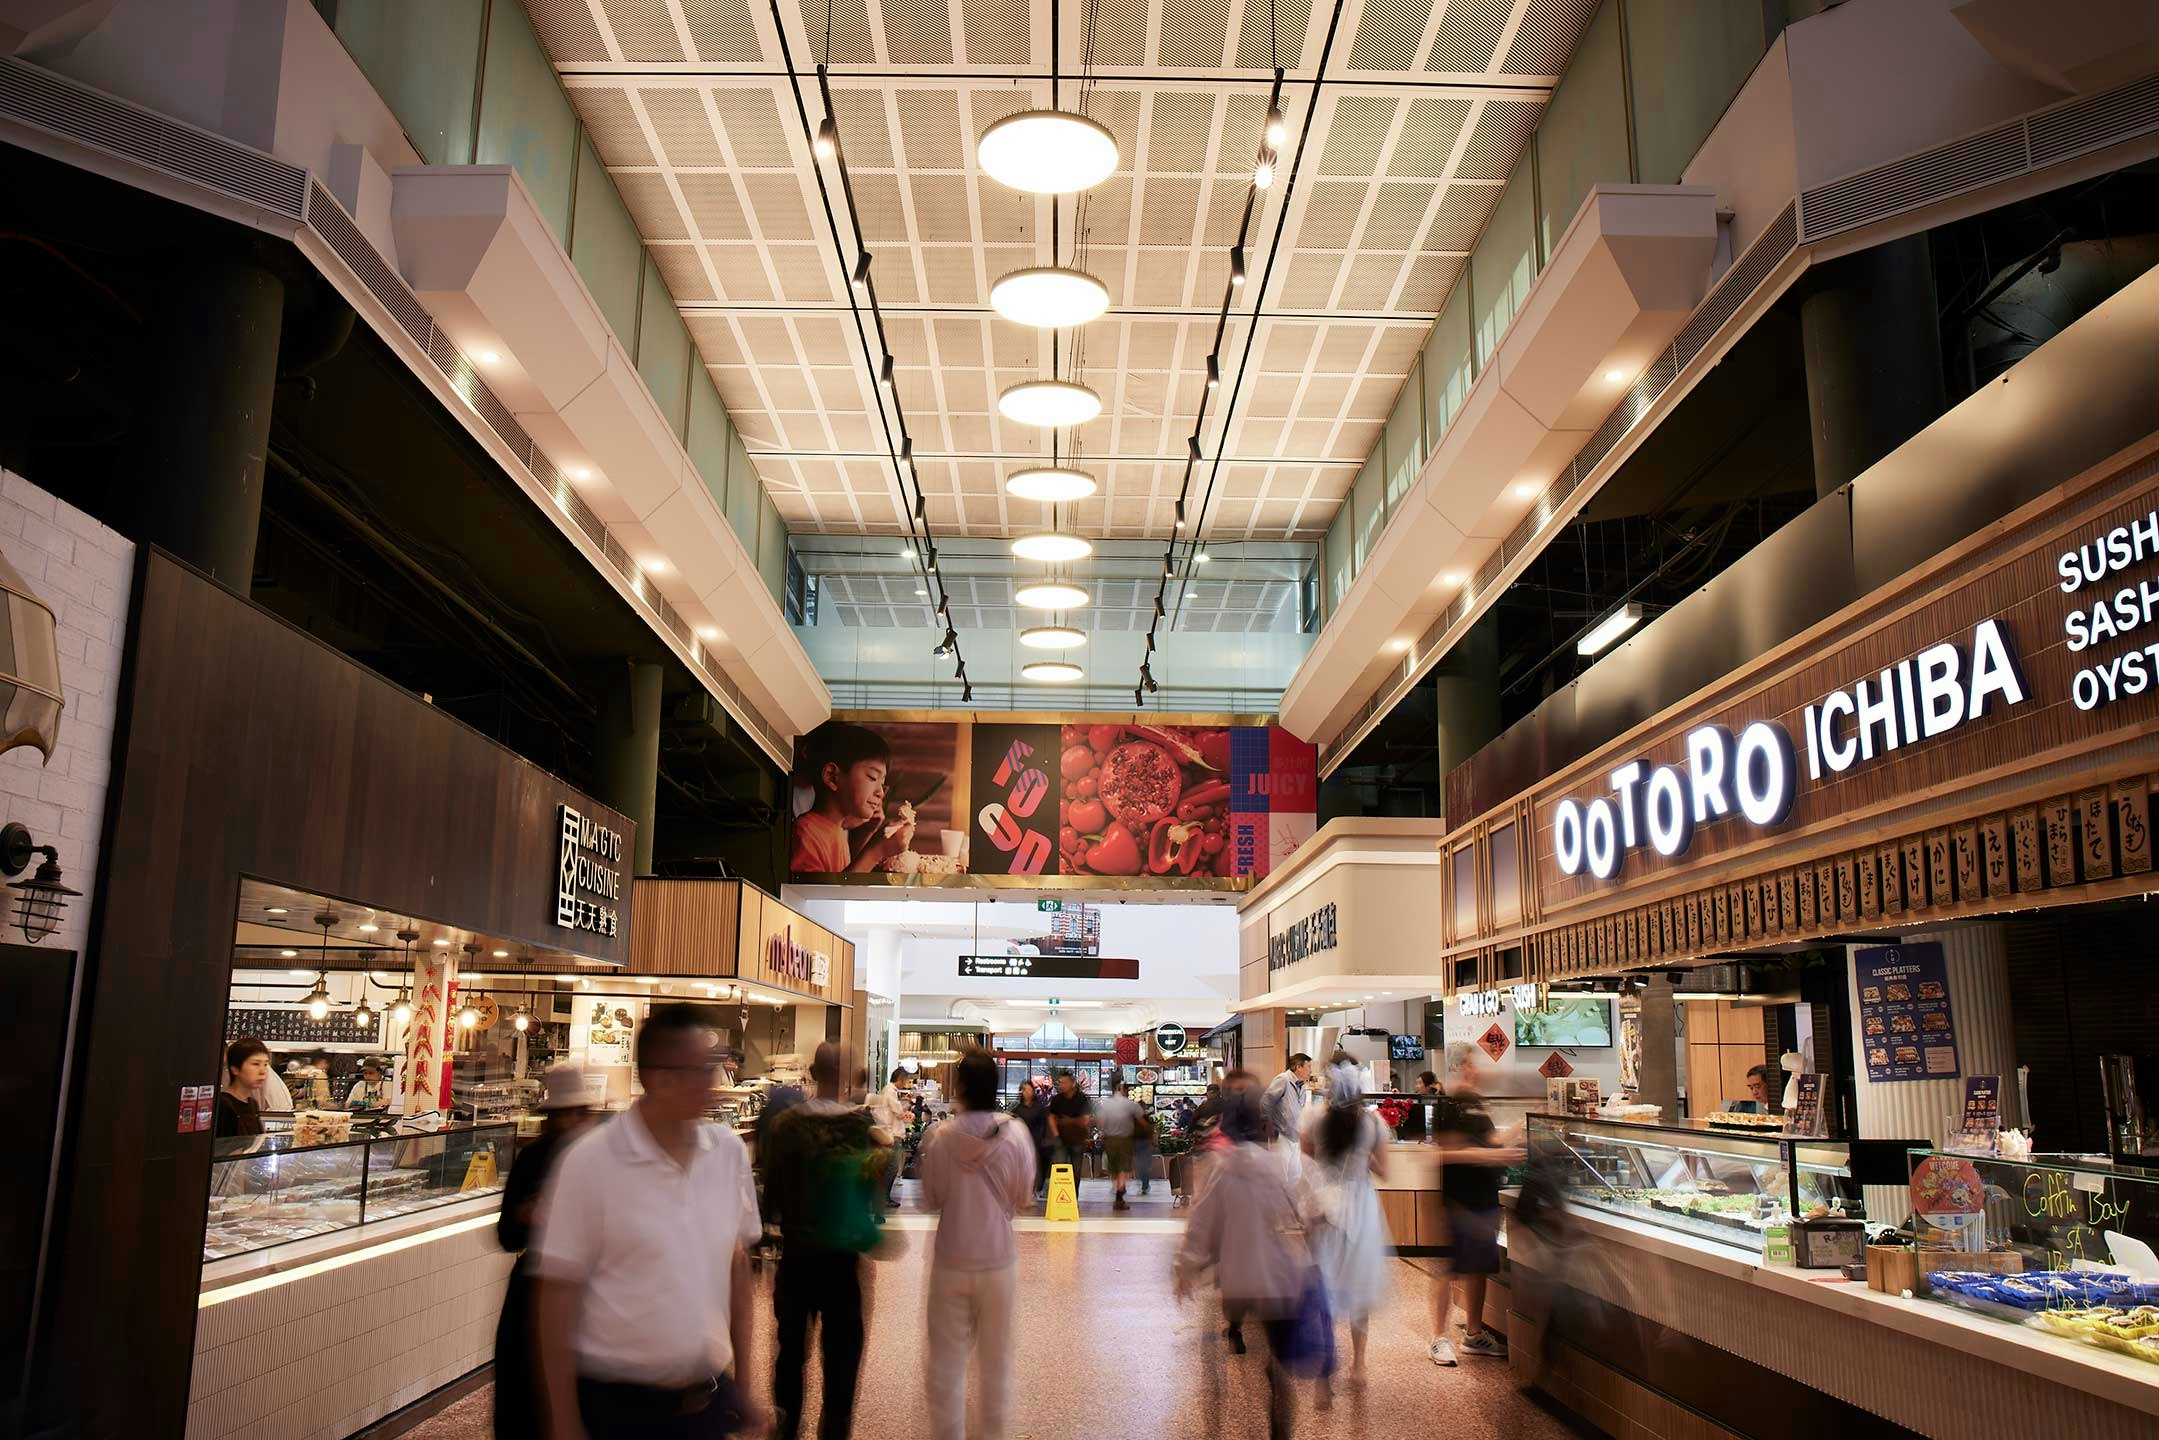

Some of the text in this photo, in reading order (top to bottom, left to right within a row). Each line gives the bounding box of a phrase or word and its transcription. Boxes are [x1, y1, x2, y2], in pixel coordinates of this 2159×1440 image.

[1555, 619, 2026, 879] OOTORO ICHIBA
[1248, 773, 1307, 795] JUICY
[581, 816, 622, 862] MAGIC
[1237, 824, 1255, 875] FRESH
[2018, 818, 2034, 872] いくら
[2085, 800, 2102, 860] ほたて
[1933, 841, 1946, 885] かに
[1988, 829, 2004, 878] えび
[579, 856, 620, 900] CUISINE
[975, 966, 1003, 975] Transport
[1872, 965, 1921, 977] CLASSIC PLATTERS
[1485, 988, 1499, 1014] GO
[1513, 983, 1537, 1010] SUSHI
[1929, 1160, 1960, 1171] WELCOME
[2023, 1172, 2130, 1234] Coffin Bay
